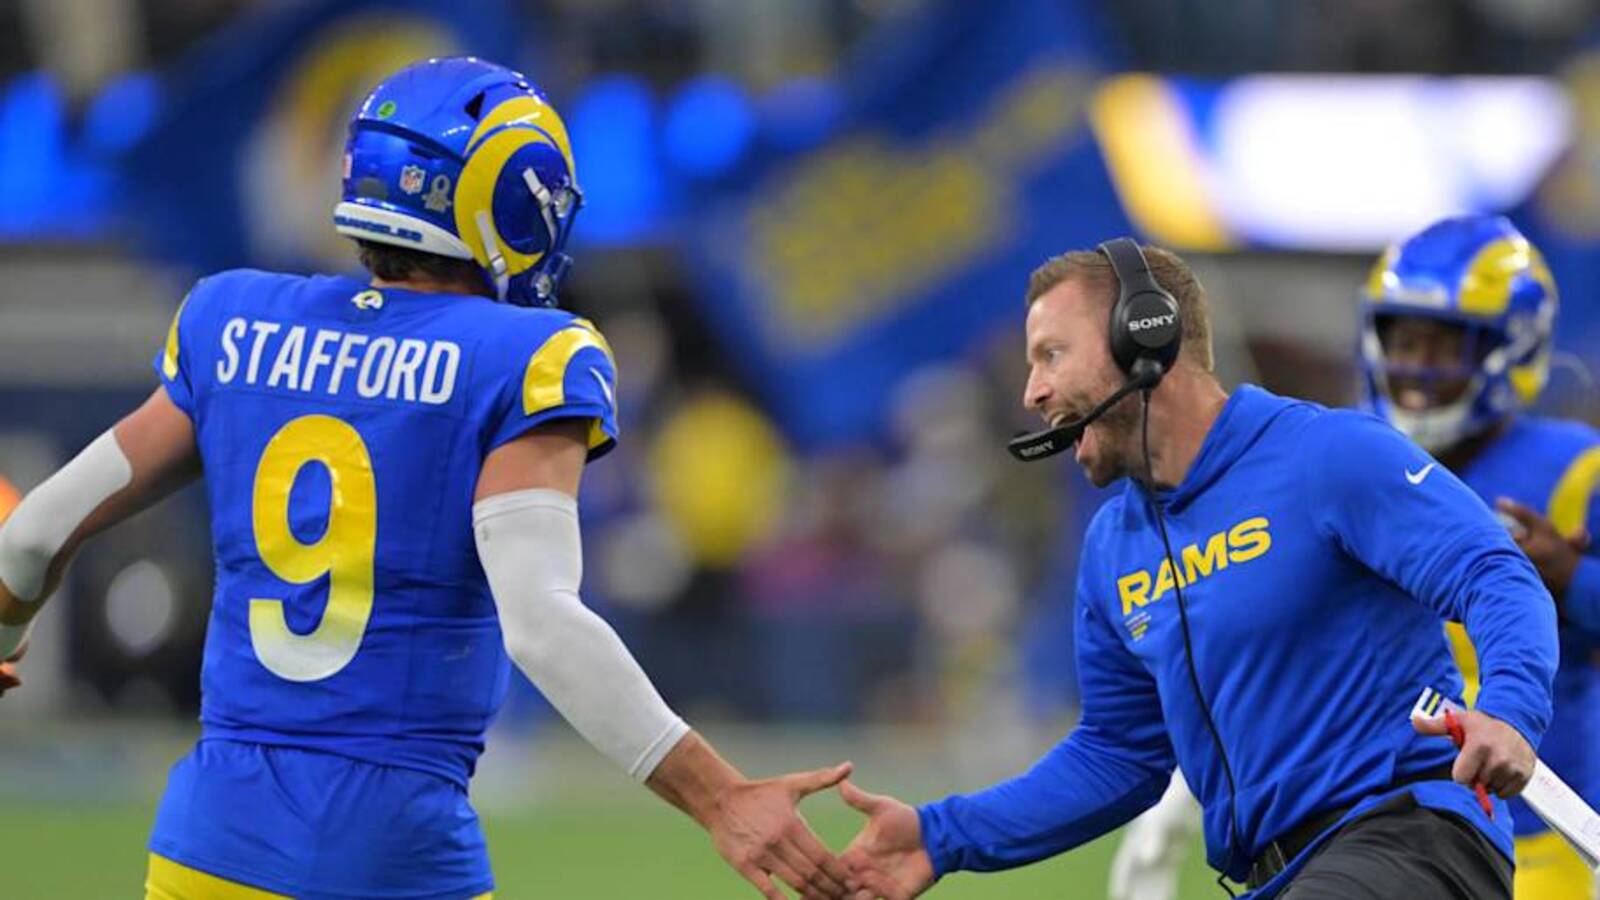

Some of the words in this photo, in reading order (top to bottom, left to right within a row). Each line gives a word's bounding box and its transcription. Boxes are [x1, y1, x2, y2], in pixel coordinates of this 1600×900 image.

[216, 317, 460, 404] STAFFORD
[1128, 314, 1174, 331] SONY
[249, 414, 377, 682] 9
[1117, 517, 1272, 616] RAMS
